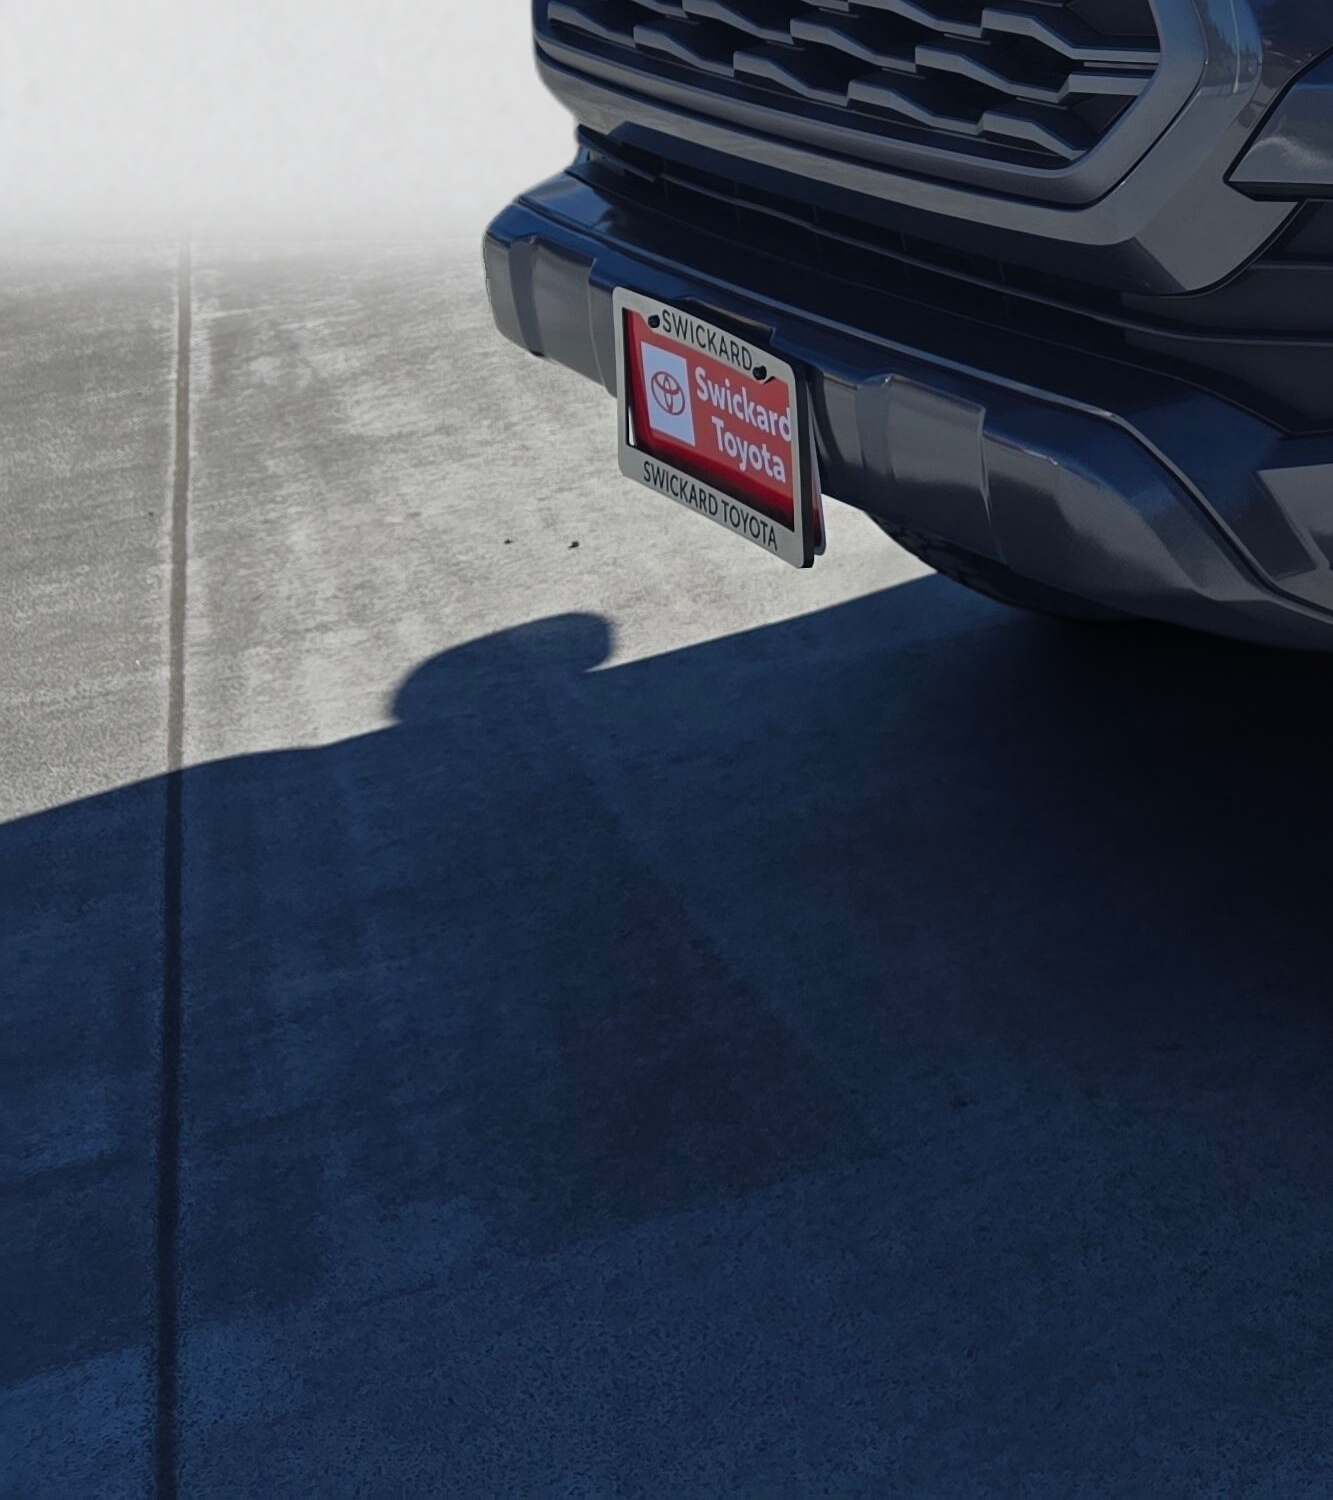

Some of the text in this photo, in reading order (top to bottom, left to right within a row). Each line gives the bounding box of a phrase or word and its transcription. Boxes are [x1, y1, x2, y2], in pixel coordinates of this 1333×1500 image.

[661, 308, 754, 372] SWICKARD
[694, 366, 792, 442] Swickard
[711, 415, 787, 484] Toyota
[642, 461, 779, 552] SWICKARD TOYOTA
